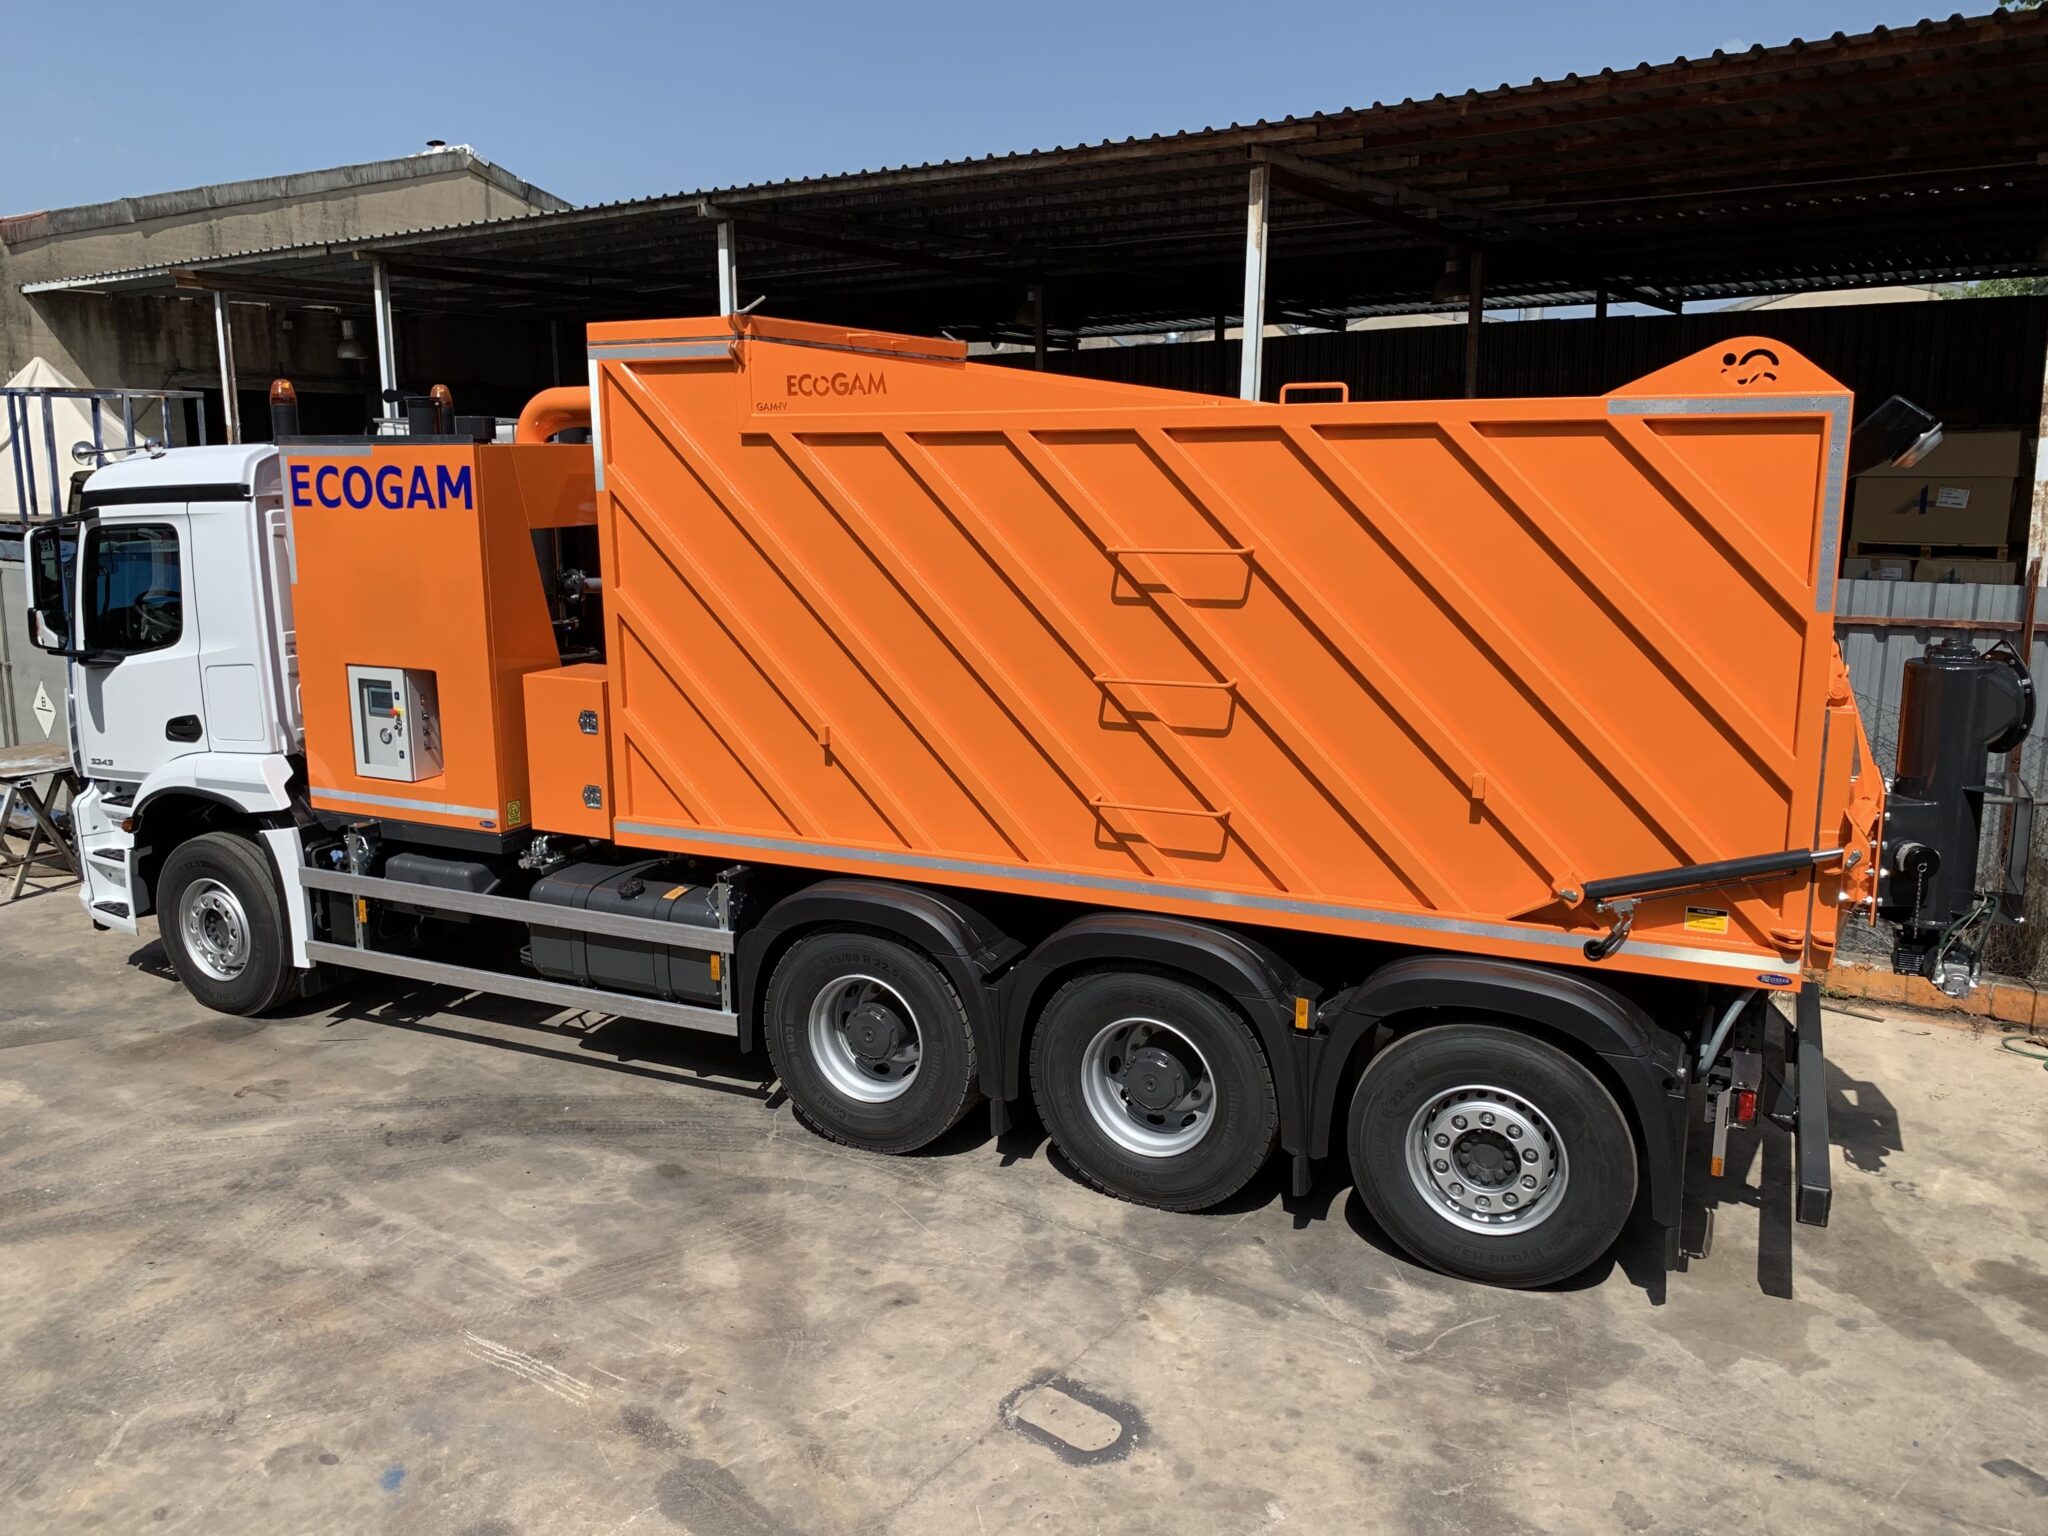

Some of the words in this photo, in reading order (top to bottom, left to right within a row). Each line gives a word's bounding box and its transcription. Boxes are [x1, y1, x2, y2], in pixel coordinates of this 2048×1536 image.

[786, 372, 887, 397] ECOGAM
[756, 402, 788, 412] GAM-IV
[290, 465, 473, 510] ECOGAM
